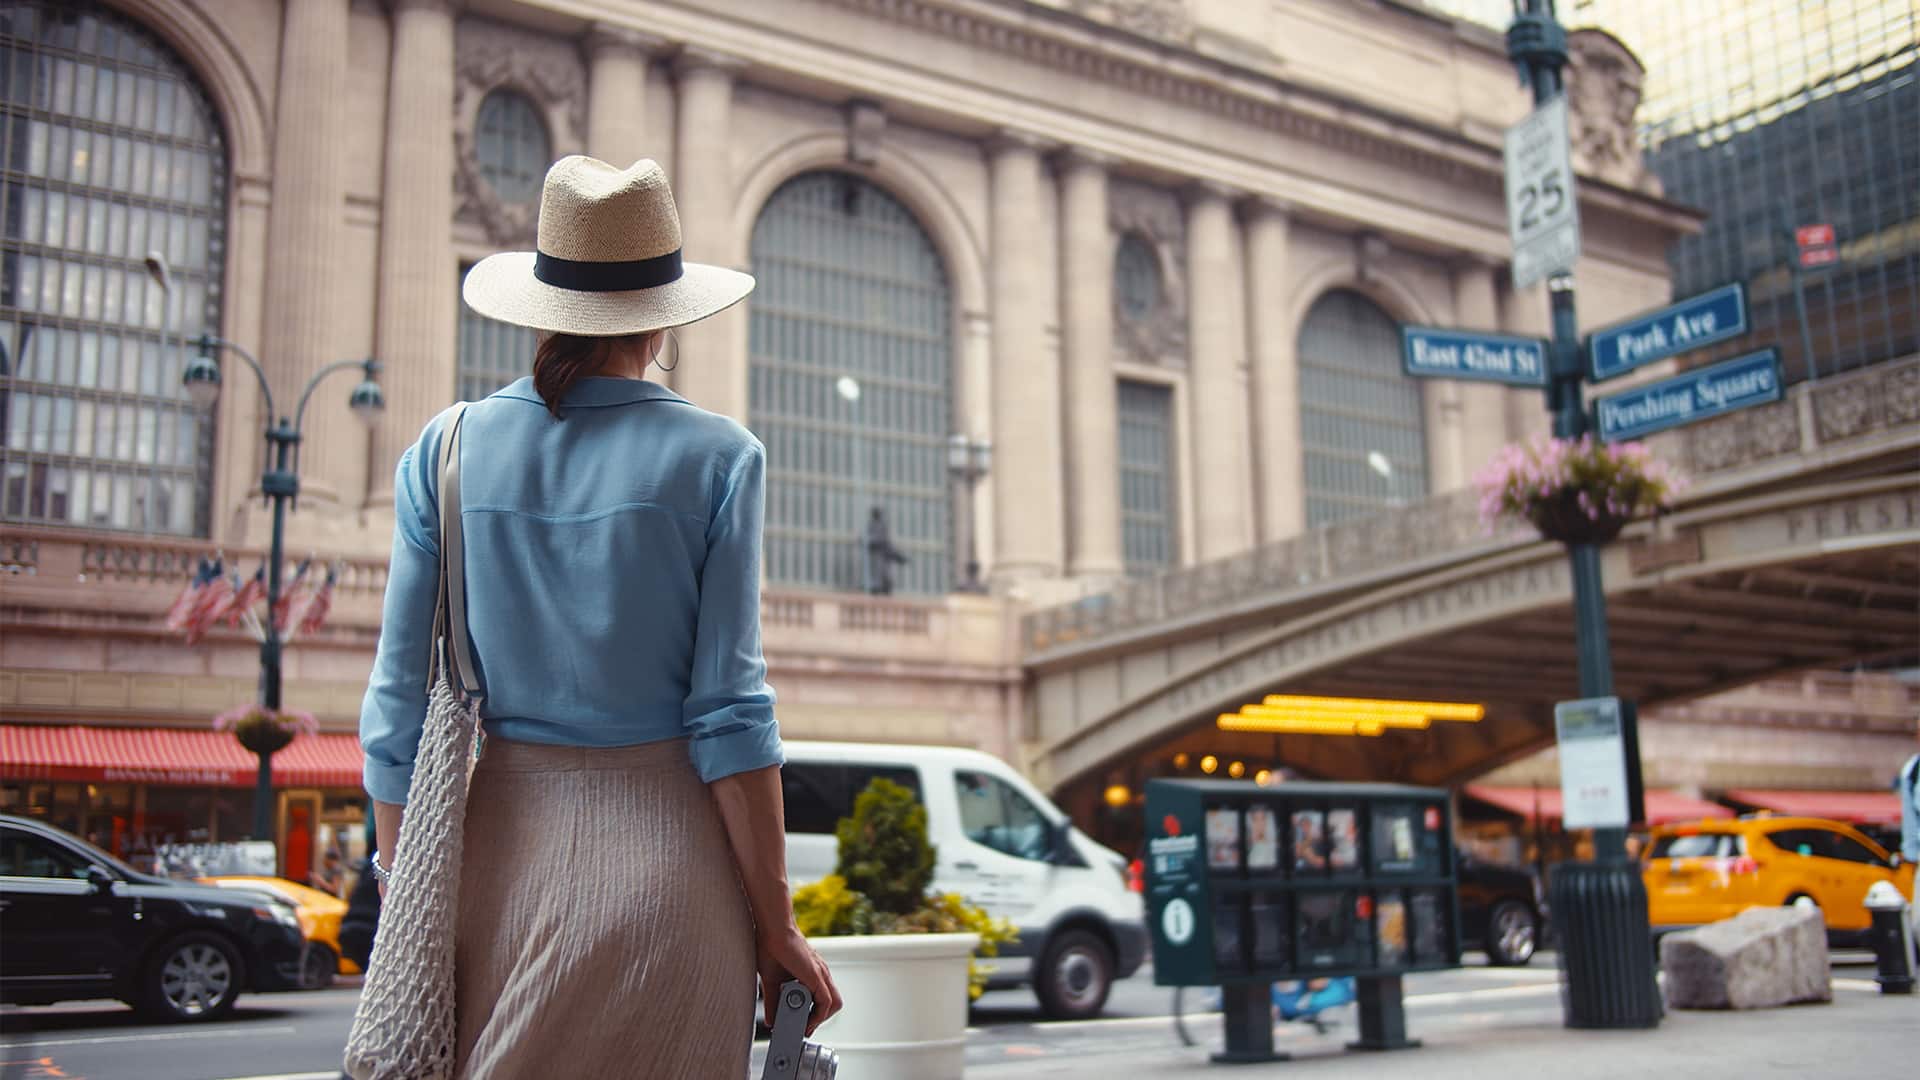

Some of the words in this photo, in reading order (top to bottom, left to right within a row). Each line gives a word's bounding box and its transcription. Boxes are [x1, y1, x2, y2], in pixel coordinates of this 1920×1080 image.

[1518, 169, 1564, 230] 25
[1412, 336, 1459, 366] East
[1464, 341, 1511, 370] 42nd
[1515, 346, 1538, 374] St
[1616, 325, 1668, 363] Park
[1672, 307, 1718, 343] Ave
[1604, 386, 1693, 430] Pershing
[1697, 366, 1773, 410] Square
